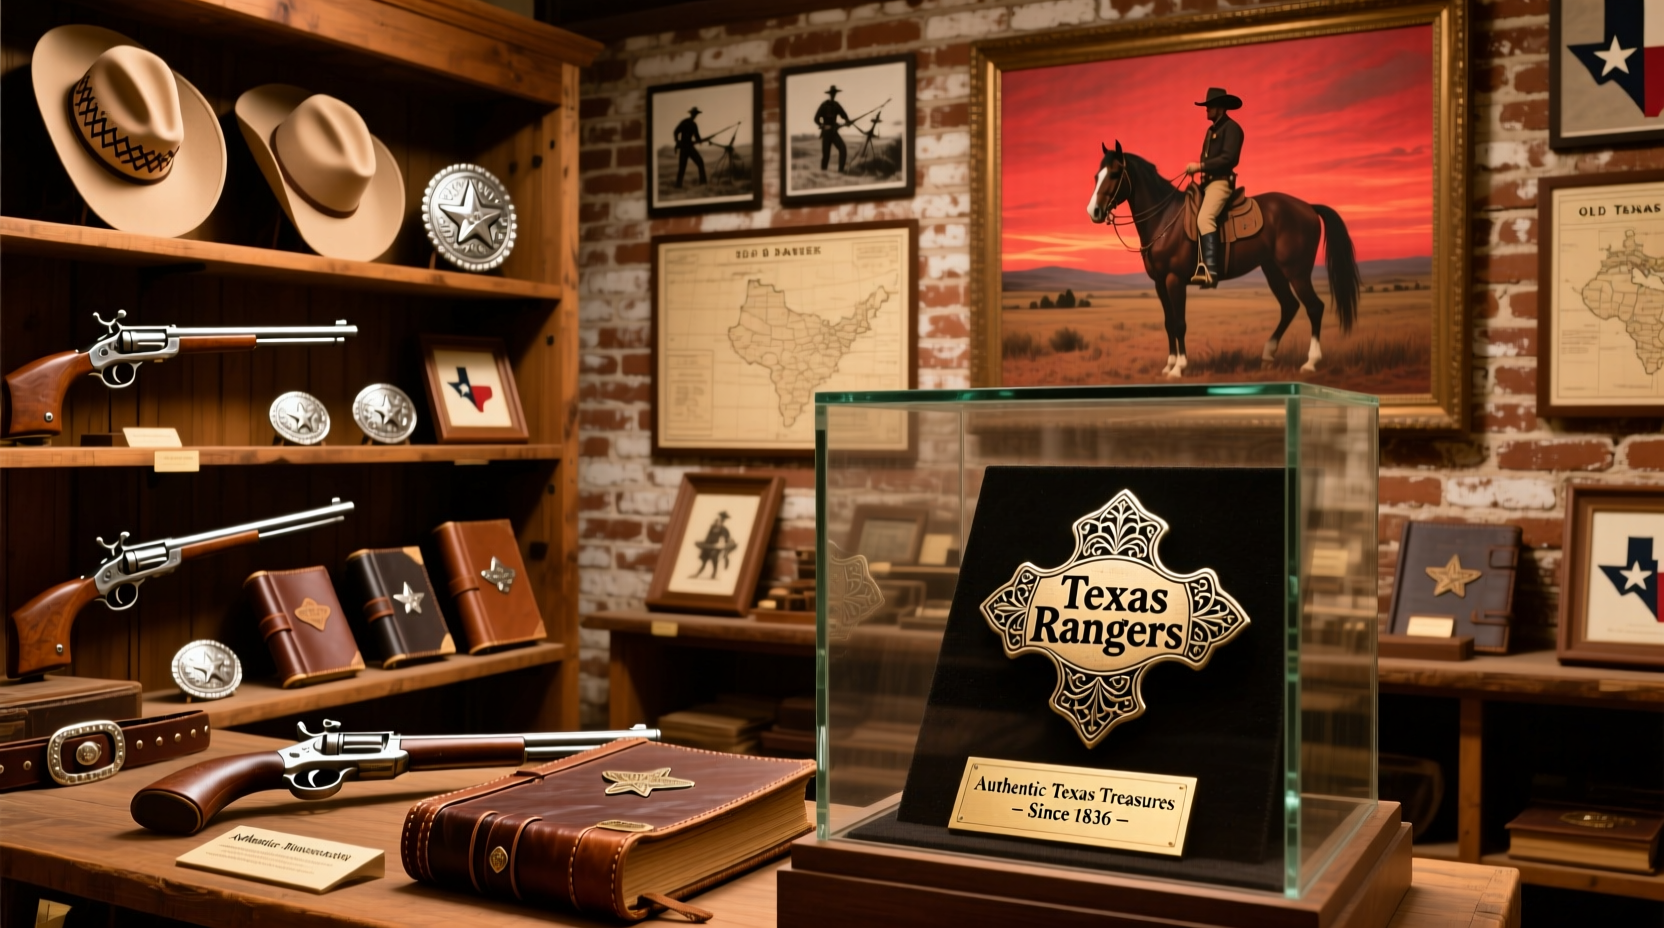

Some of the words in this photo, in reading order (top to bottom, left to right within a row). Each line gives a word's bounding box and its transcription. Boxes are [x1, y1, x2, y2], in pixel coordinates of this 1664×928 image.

[1578, 206, 1606, 217] OLD
[1061, 575, 1169, 614] Texas
[1029, 605, 1183, 657] Rangers
[974, 776, 1047, 797] Authentic
[1052, 783, 1096, 802] Texas
[1100, 788, 1176, 811] Treasures
[1027, 802, 1070, 821] Since
[1074, 808, 1112, 826] 1836
